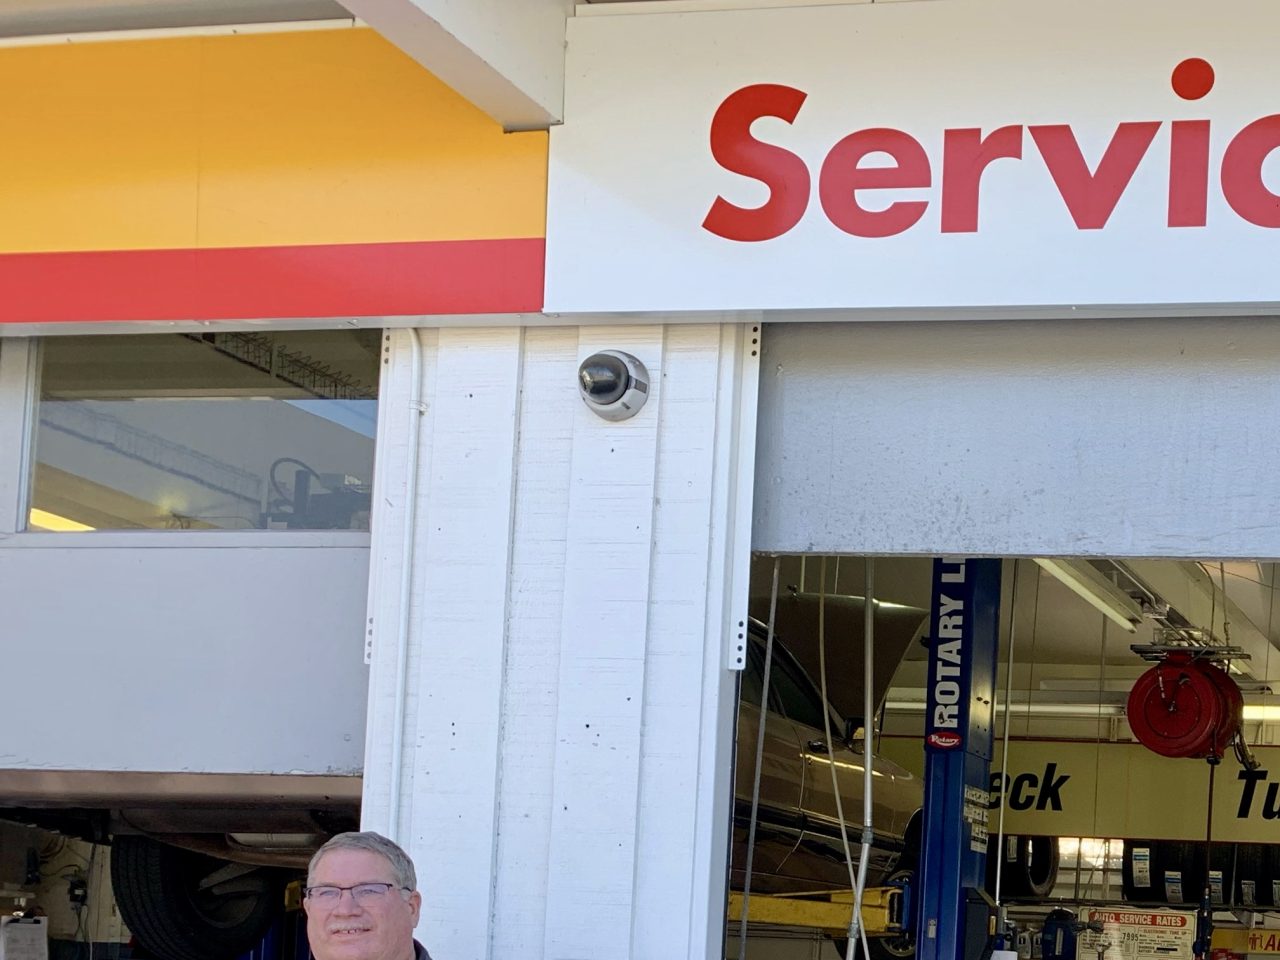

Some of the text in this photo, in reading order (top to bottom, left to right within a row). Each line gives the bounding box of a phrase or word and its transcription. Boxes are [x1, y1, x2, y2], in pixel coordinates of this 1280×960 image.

[934, 593, 963, 728] ROTARY
[1120, 914, 1152, 924] SERVICE
[1156, 916, 1182, 926] RATES
